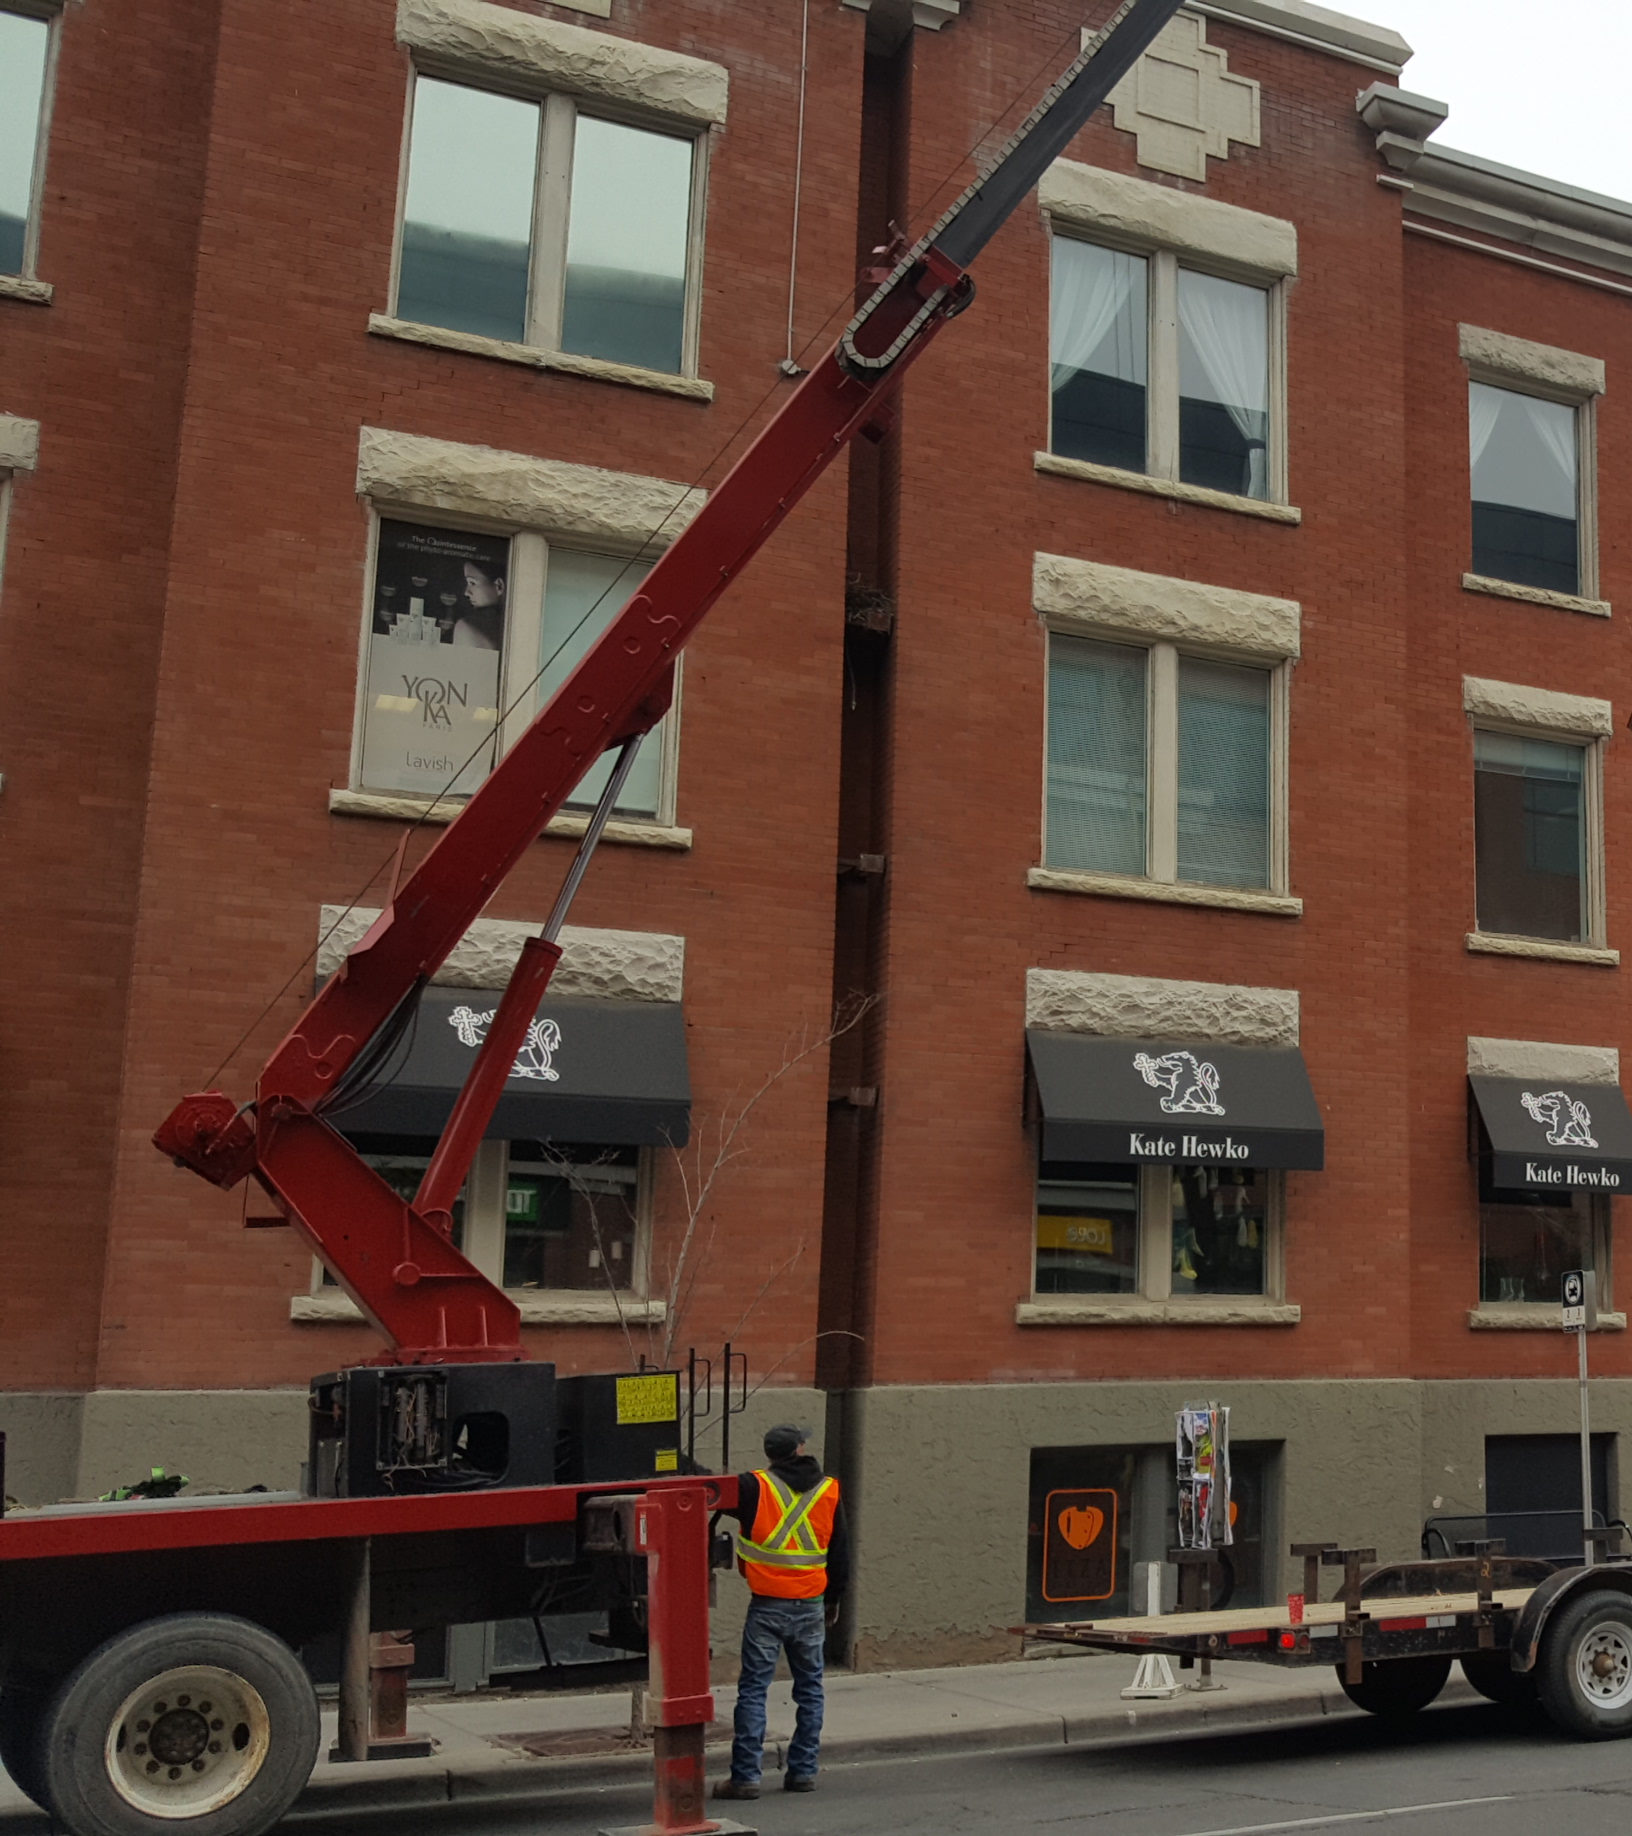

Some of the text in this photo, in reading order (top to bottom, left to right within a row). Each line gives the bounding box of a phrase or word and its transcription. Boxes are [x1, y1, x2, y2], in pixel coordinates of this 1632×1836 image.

[411, 535, 477, 551] The Quintessence
[402, 675, 468, 707] YON
[424, 690, 452, 726] KA
[1129, 1132, 1249, 1160] Kate Hewko
[1525, 1162, 1620, 1187] Kate Hewko
